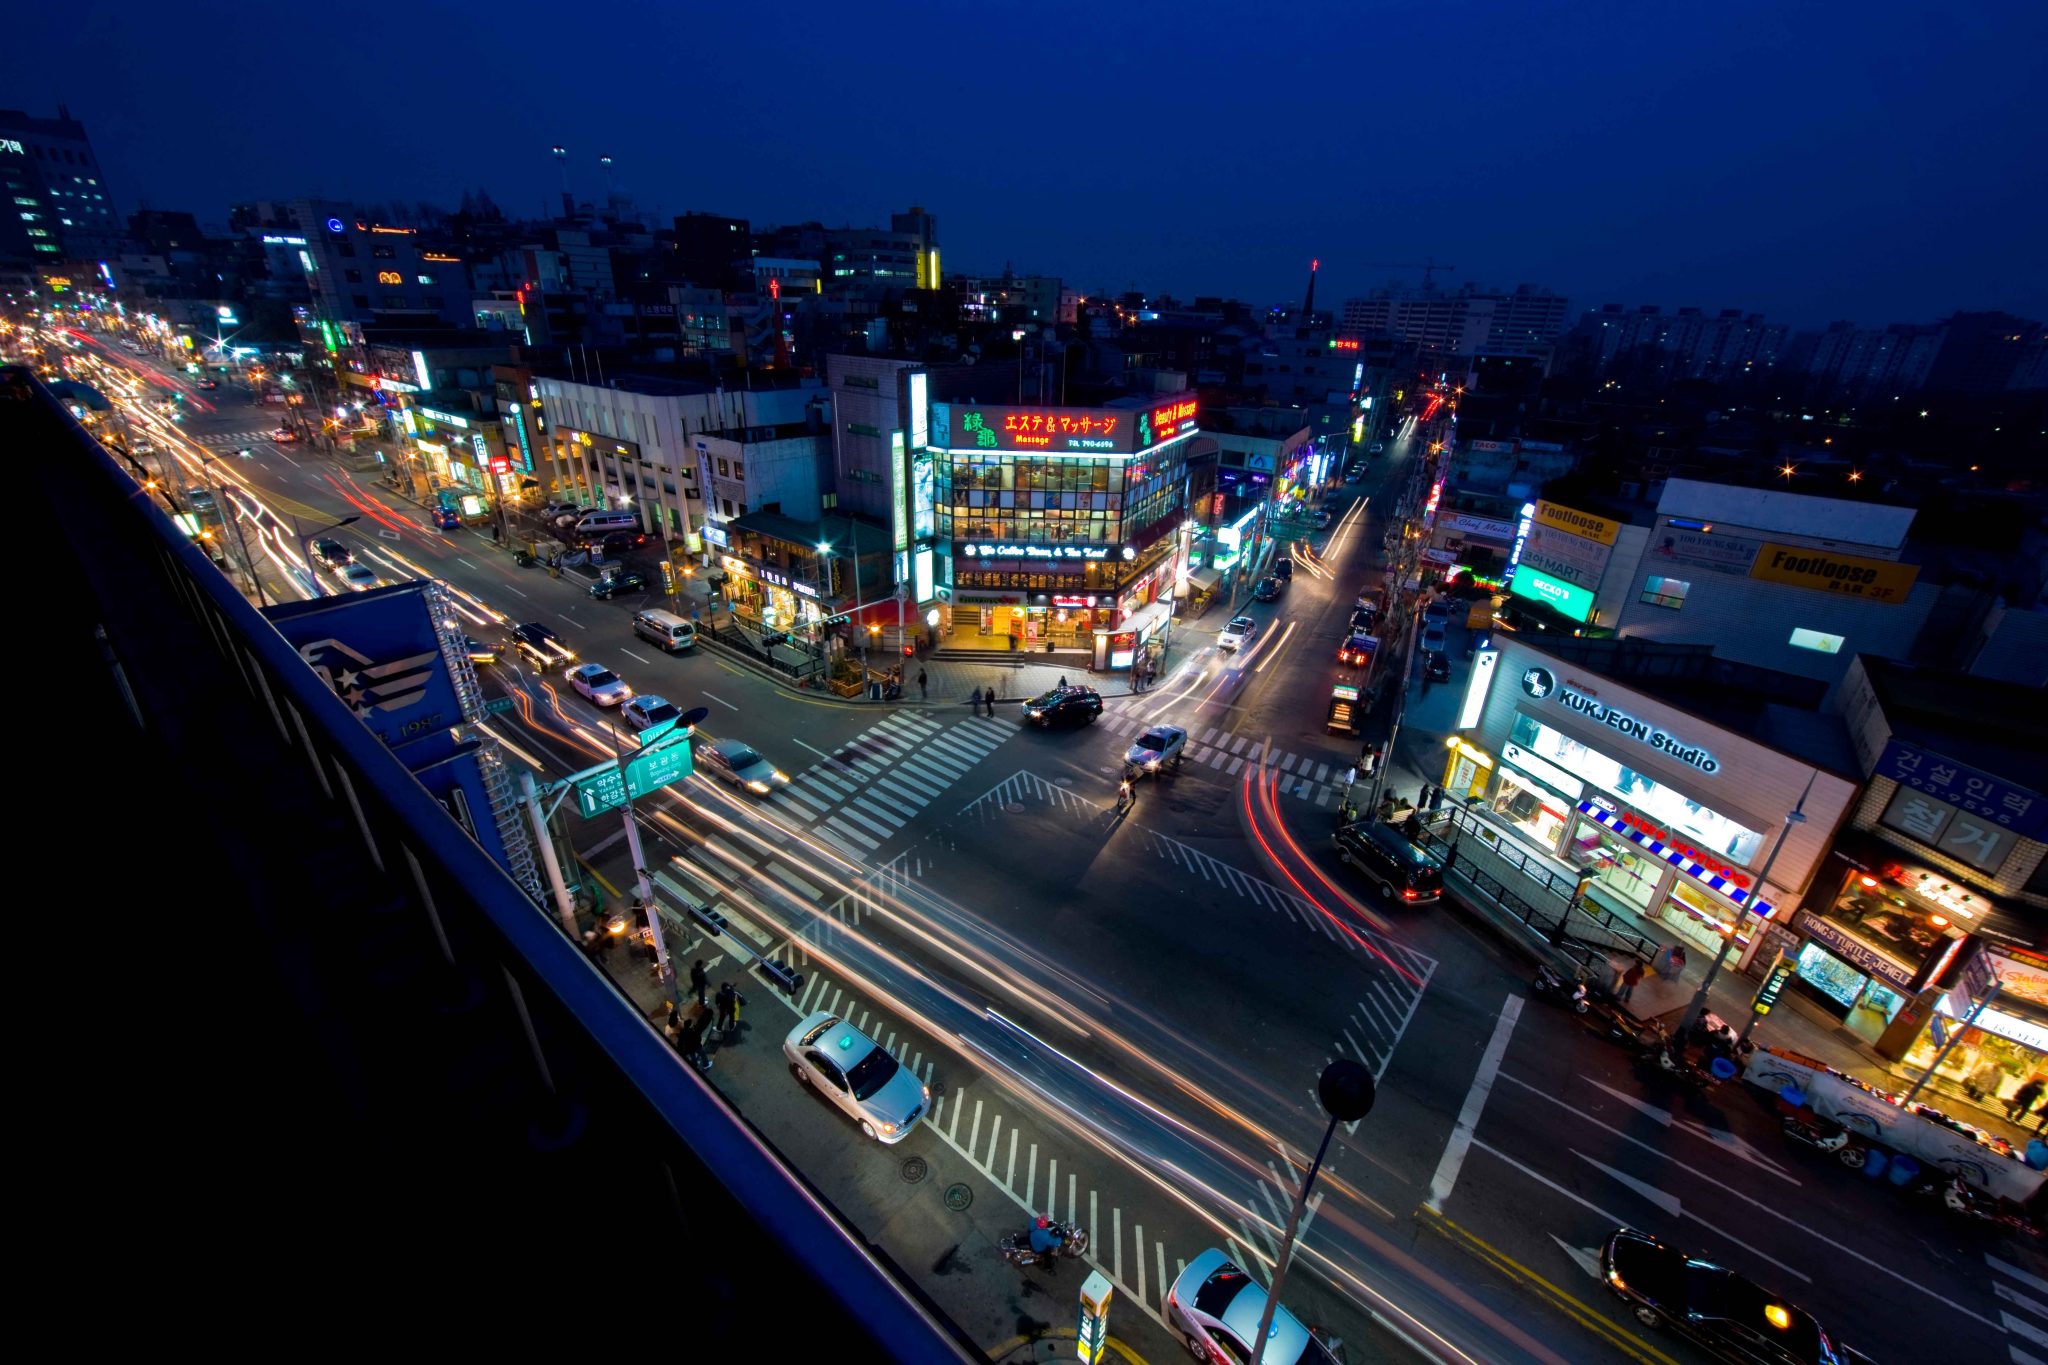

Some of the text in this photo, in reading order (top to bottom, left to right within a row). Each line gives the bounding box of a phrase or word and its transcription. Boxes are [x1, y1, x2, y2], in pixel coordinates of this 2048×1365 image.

[1155, 408, 1173, 426] Beauty
[1015, 434, 1049, 446] Massage
[1541, 503, 1604, 532] Footloose
[997, 546, 1024, 555] Coffee
[1771, 551, 1877, 584] Footloose
[1533, 578, 1569, 600] GECKO'S
[1828, 580, 1894, 599] BAR 3F
[401, 713, 442, 736] 1987
[1559, 689, 1717, 773] KUKJEON Studio
[1896, 750, 2033, 817] 건설인력
[1896, 770, 2013, 824] 793-9595
[1902, 798, 2000, 864] 철거
[1669, 838, 1750, 888] HOTDOG
[1835, 931, 1872, 963] TURTLE
